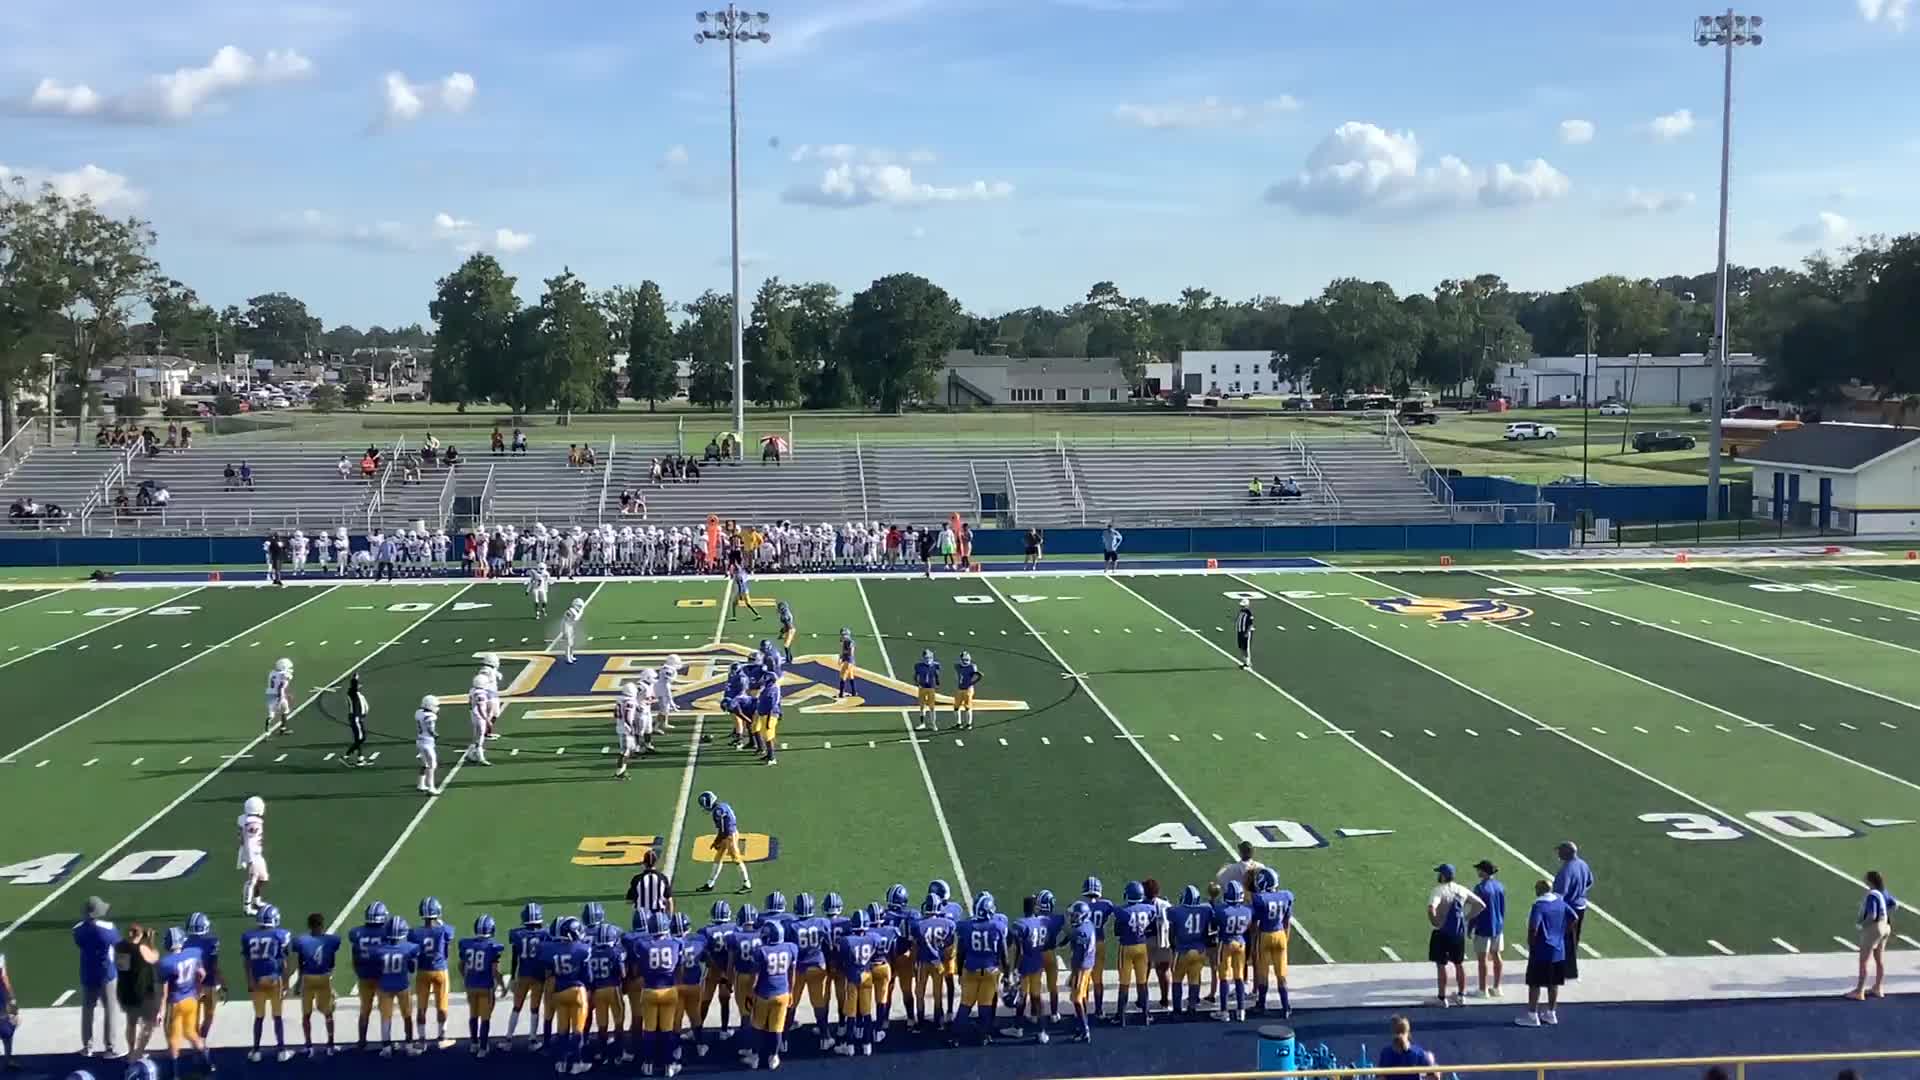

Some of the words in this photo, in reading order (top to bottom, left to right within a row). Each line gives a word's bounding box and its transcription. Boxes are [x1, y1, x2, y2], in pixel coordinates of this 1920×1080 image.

[386, 602, 493, 612] 40
[954, 594, 1049, 604] 40
[1127, 819, 1320, 850] 40
[1637, 810, 1856, 841] 30
[570, 833, 771, 866] 50
[0, 850, 208, 885] 40
[1184, 913, 1201, 934] 41
[423, 938, 435, 956] 2
[798, 926, 819, 948] 60
[971, 931, 992, 952] 61
[249, 937, 274, 960] 27
[312, 945, 323, 966] 4
[380, 953, 403, 974] 10
[464, 948, 486, 971] 38
[552, 954, 573, 975] 15
[768, 952, 788, 976] 99
